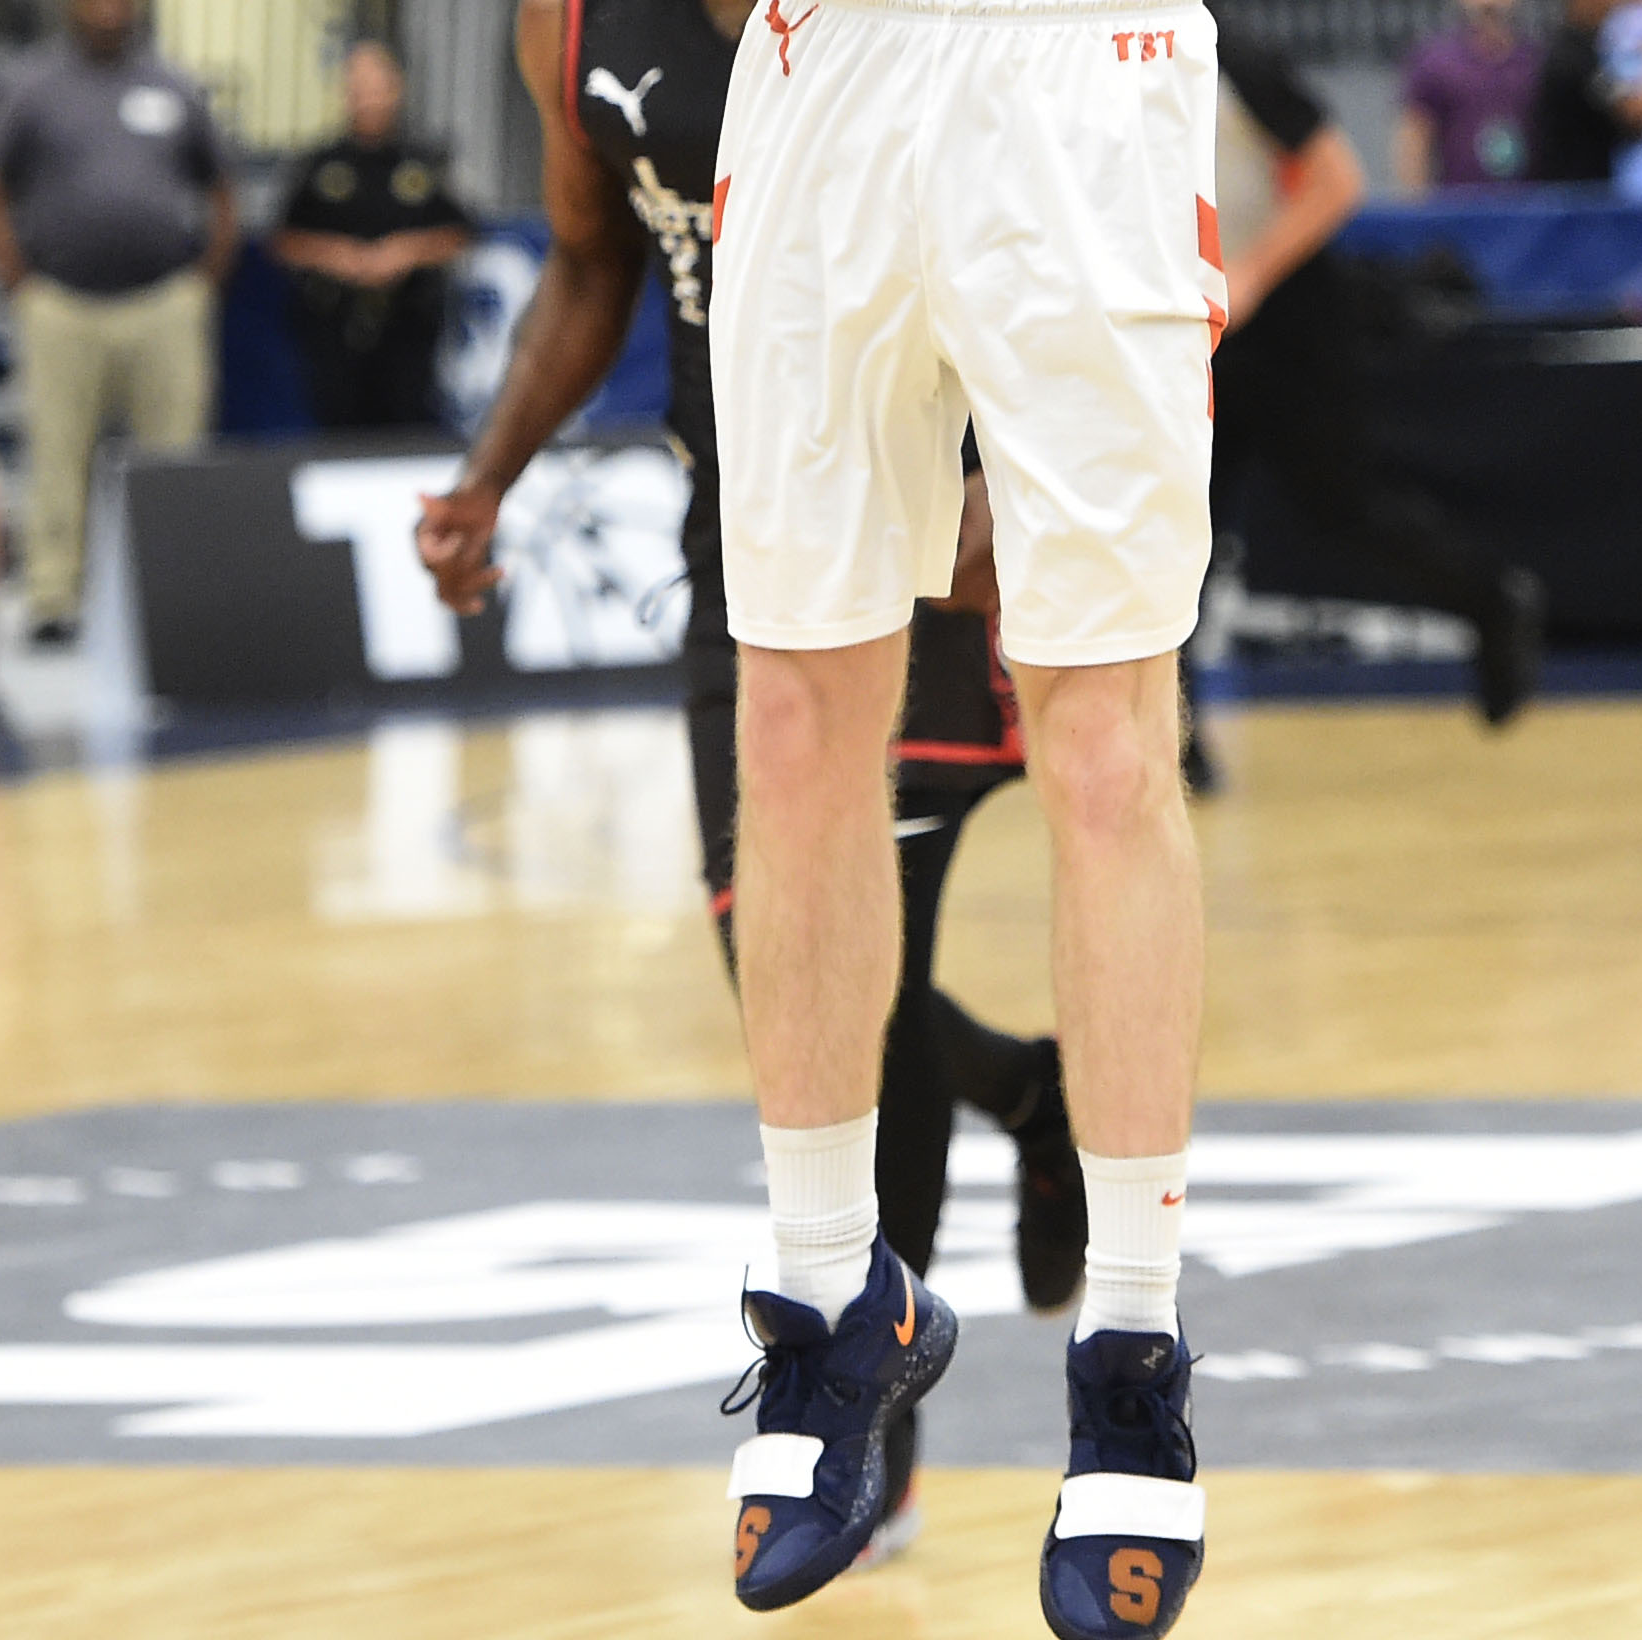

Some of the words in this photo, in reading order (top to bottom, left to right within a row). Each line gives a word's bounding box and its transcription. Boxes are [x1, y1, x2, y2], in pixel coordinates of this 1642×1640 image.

[1111, 29, 1175, 62] TBT
[291, 448, 695, 680] TB
[1108, 1546, 1164, 1627] S
